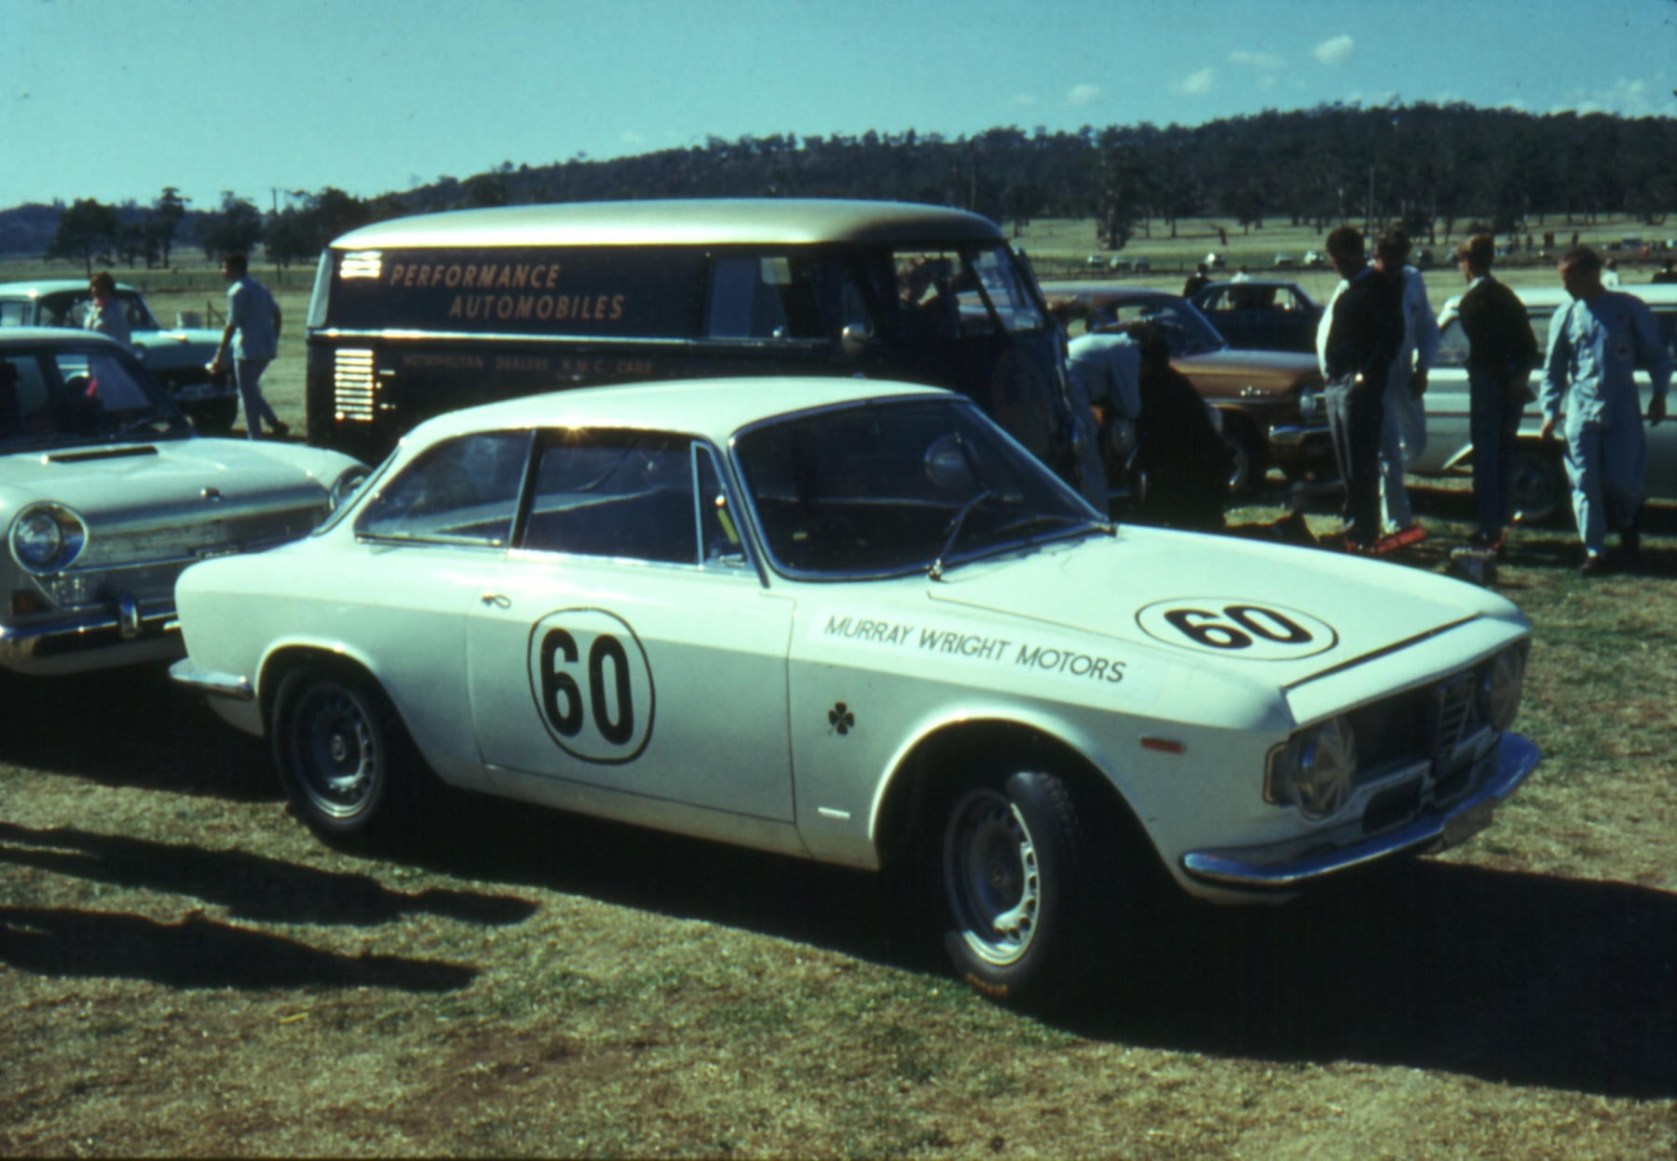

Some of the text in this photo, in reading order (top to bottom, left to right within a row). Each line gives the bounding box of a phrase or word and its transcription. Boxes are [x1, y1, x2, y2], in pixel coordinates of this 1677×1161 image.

[390, 264, 560, 289] PERFORMANCE
[449, 294, 625, 321] AUTOMOBILES
[825, 616, 1127, 684] MURRAY WRIGHT MOTORS
[1164, 605, 1313, 650] 60
[540, 627, 634, 745] 60
